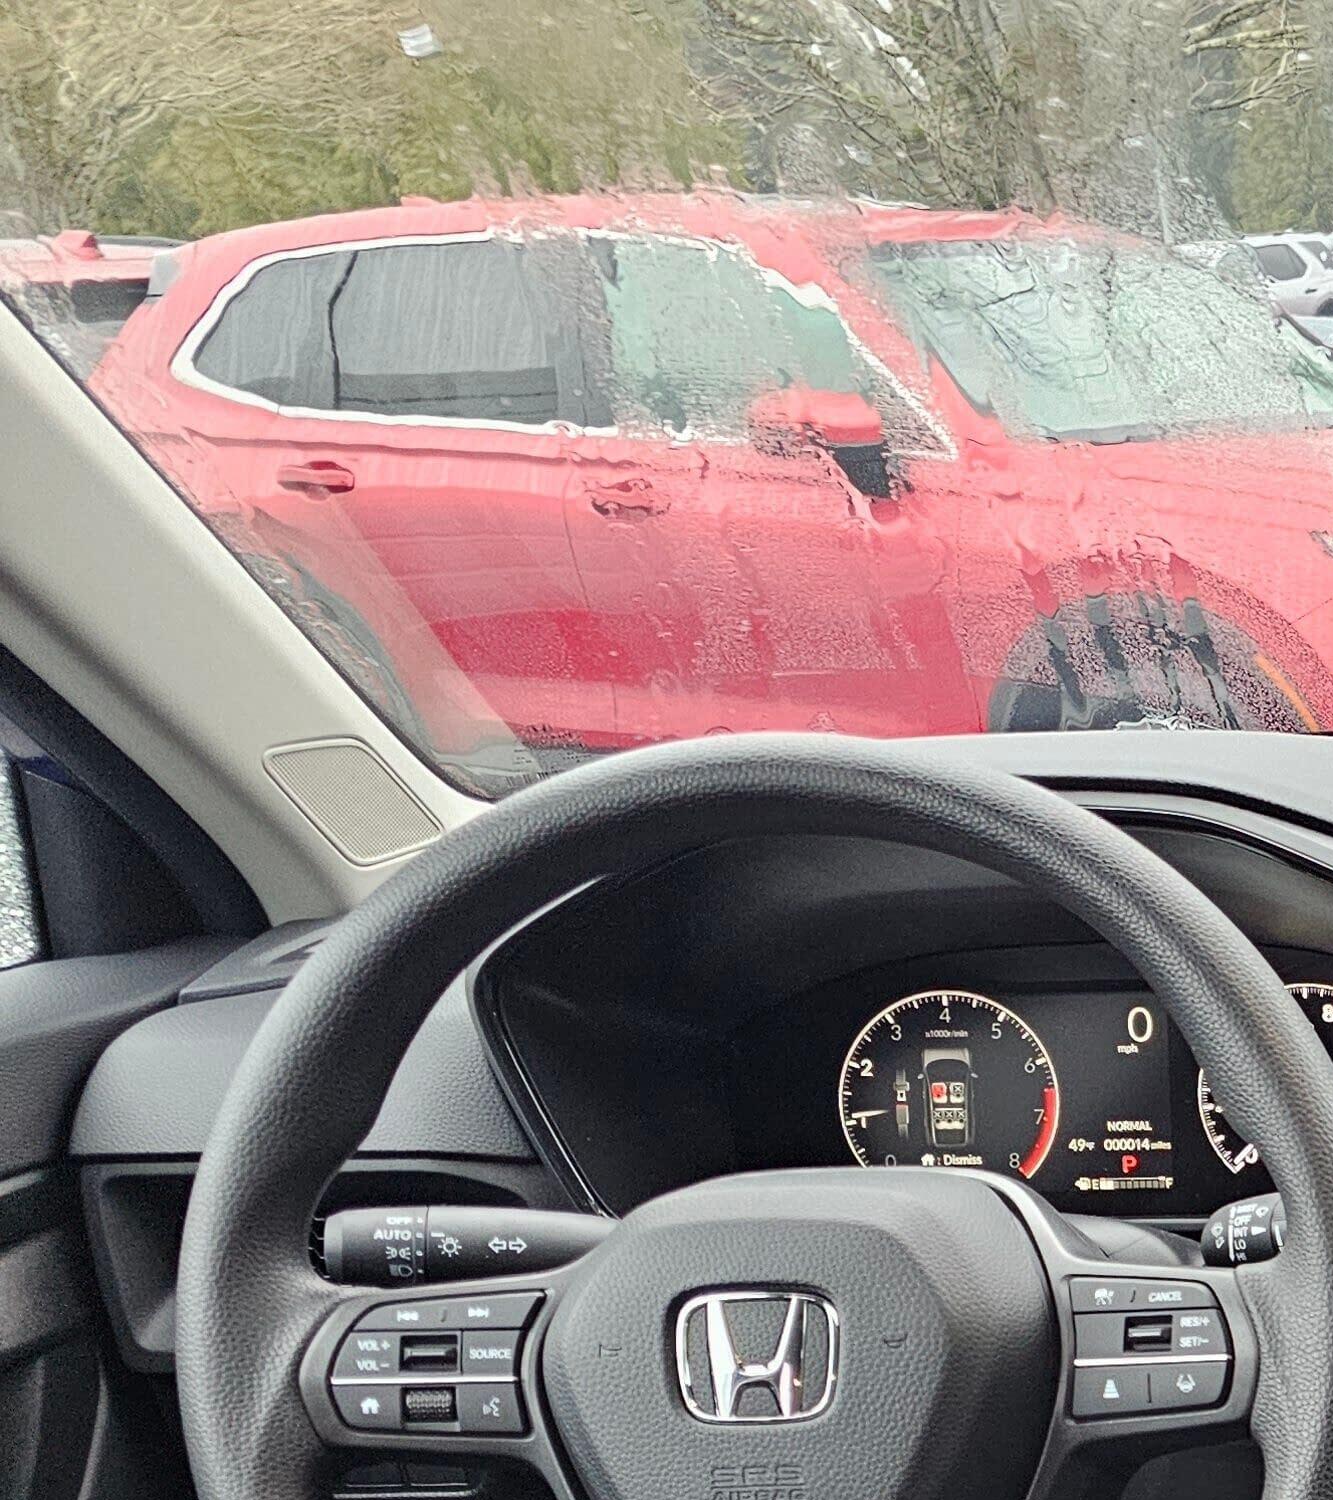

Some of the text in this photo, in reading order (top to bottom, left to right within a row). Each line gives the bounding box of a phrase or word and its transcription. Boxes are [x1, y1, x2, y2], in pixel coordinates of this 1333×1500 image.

[939, 1007, 951, 1023] 4
[891, 1024, 902, 1041] 3
[991, 1023, 1002, 1039] 5
[1127, 1006, 1154, 1043] 0
[1117, 1043, 1139, 1054] mph
[860, 1058, 874, 1076] 2
[1024, 1057, 1036, 1073] 6
[1033, 1108, 1045, 1125] 7
[1106, 1120, 1153, 1132] NORMAL
[1103, 1138, 1150, 1151] 000014
[943, 1154, 983, 1165] Dismiss
[1008, 1152, 1020, 1168] 8
[1121, 1154, 1138, 1174] P
[1234, 1214, 1252, 1226] OFF
[373, 1229, 412, 1241] AUTO
[1234, 1239, 1246, 1250] LO
[469, 1348, 512, 1360] SOURCE
